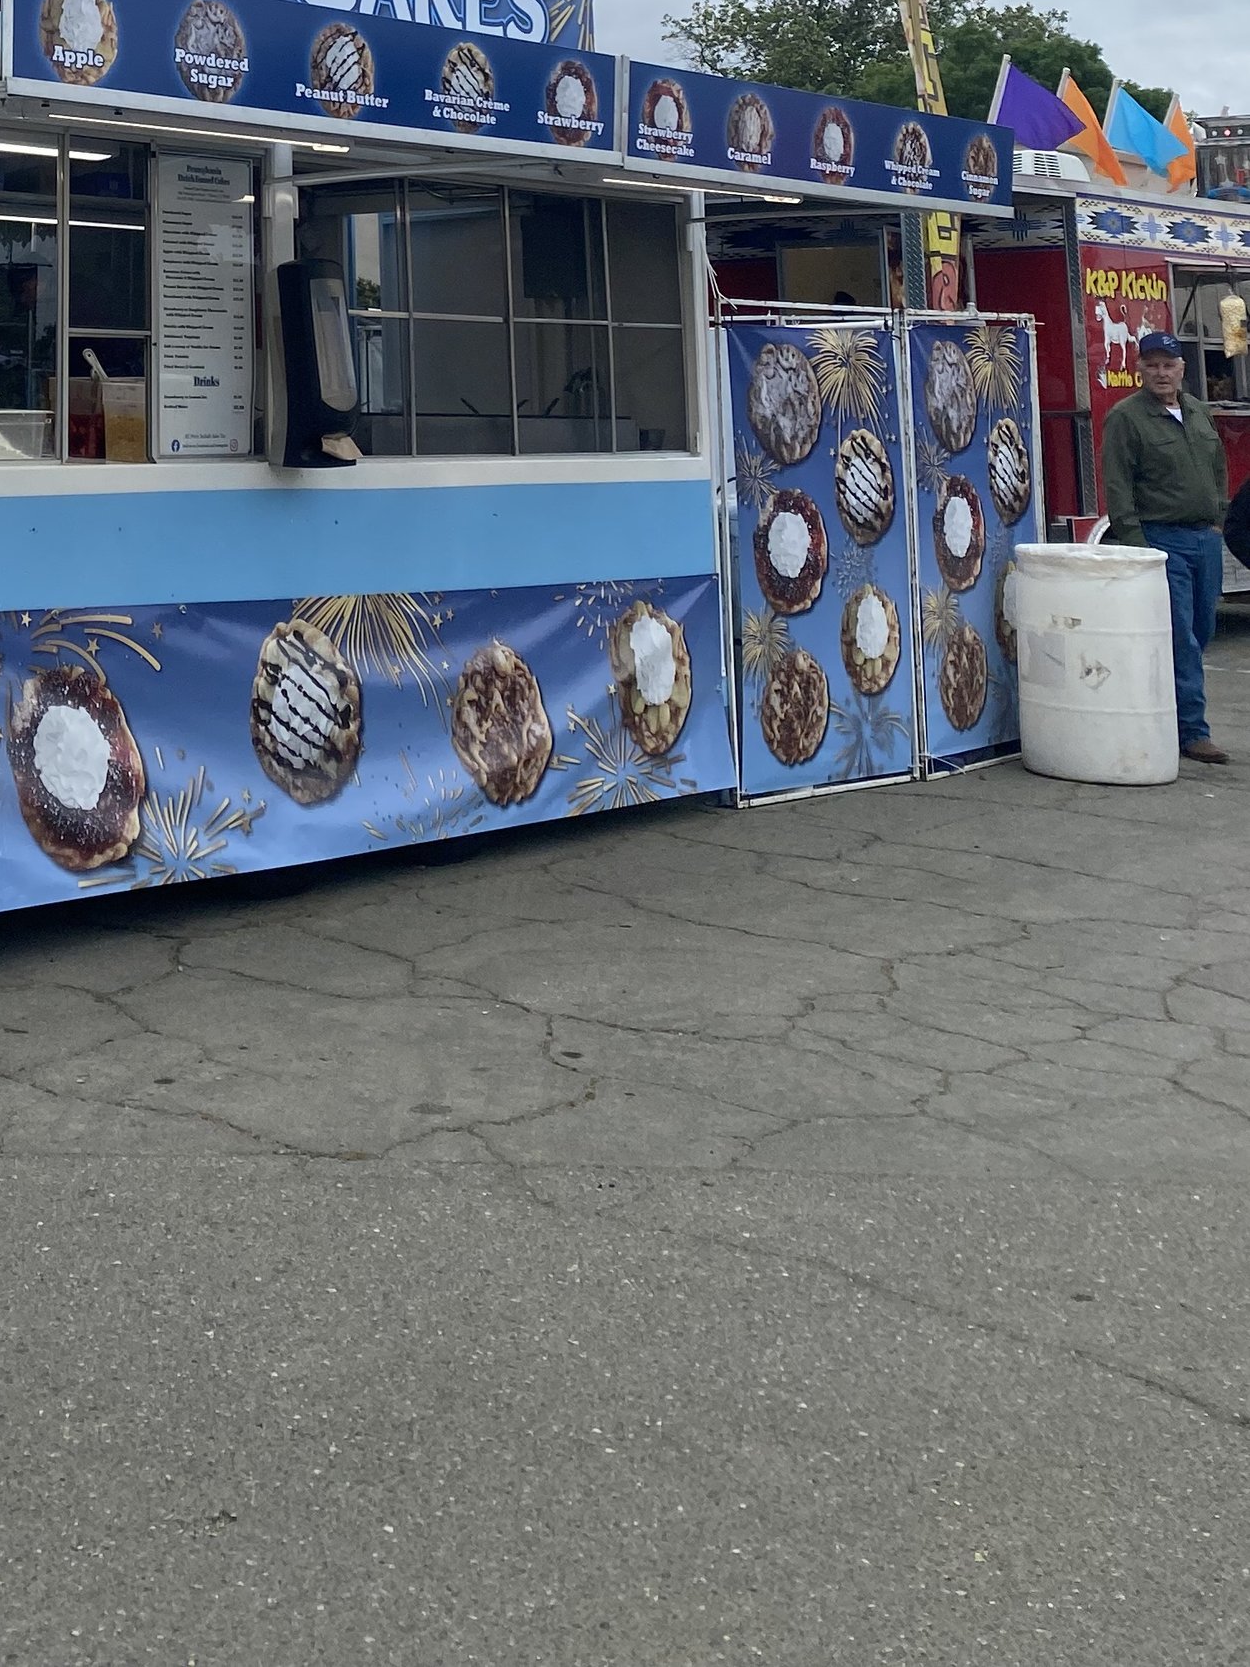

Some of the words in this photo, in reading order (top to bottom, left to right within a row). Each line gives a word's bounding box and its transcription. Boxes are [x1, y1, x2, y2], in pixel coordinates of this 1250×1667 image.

[52, 46, 105, 69] Apple
[175, 48, 249, 72] Powdered
[190, 69, 234, 89] Sugar
[295, 83, 344, 102] Peanut
[347, 90, 389, 108] Butter
[424, 89, 474, 107] Bavarian
[432, 106, 442, 118] &
[443, 109, 497, 125] Chocolate
[537, 111, 604, 135] Strawberry
[638, 123, 693, 143] Strawberry
[636, 138, 695, 157] Cheesecake
[727, 147, 772, 165] Caramel
[810, 158, 855, 177] Raspberry
[884, 160, 916, 174] Whipped
[917, 167, 940, 177] Cream
[891, 176, 897, 186] &
[898, 177, 933, 190] Chocolate
[962, 170, 998, 185] Cinnamon
[969, 185, 990, 198] Sugar
[194, 376, 220, 387] Drinks
